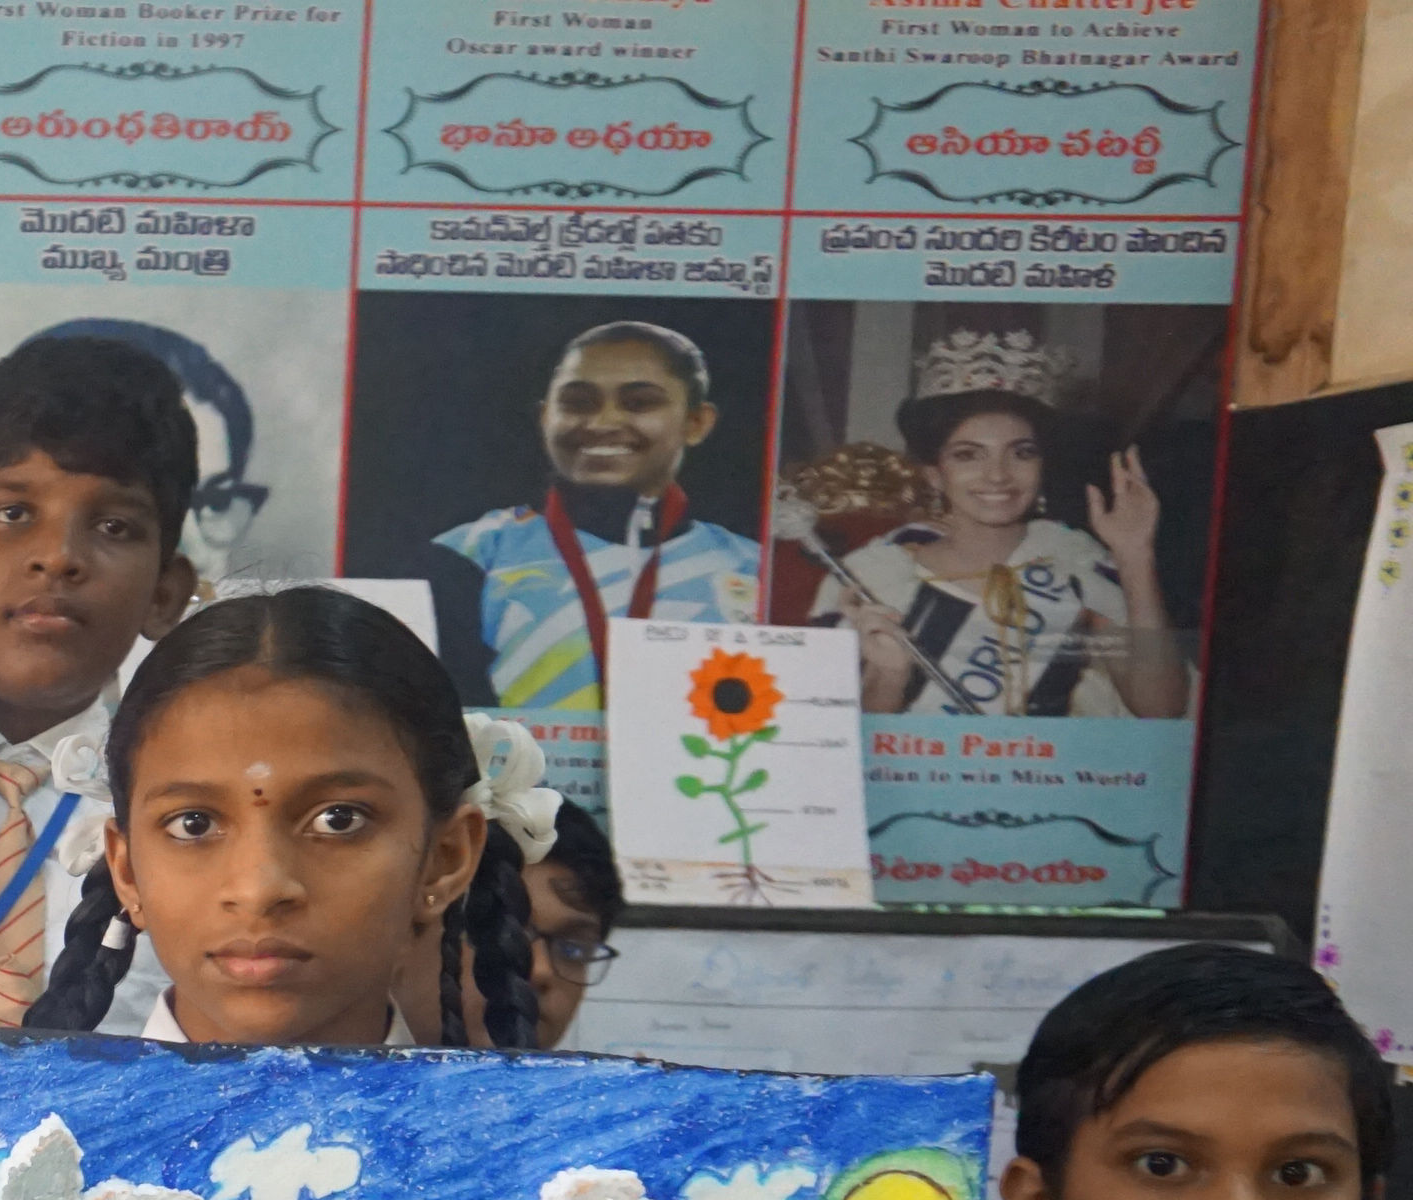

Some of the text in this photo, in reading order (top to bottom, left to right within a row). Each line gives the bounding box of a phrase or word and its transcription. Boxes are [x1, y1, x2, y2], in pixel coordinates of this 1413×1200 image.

[39, 3, 127, 19] Woman
[139, 4, 224, 20] Booker
[235, 6, 297, 22] Prize
[306, 6, 341, 23] for
[494, 11, 653, 30] First Woman
[881, 19, 1180, 38] First Woman to Achieve
[61, 31, 246, 49] Fiction in 1997
[446, 38, 698, 60] Oscar award winner
[817, 46, 1239, 70] Santhi Swaroop Bhatnagar Award
[20, 207, 255, 237] మొదటి మహిళా
[925, 259, 1116, 290] మొదటి మహిళ
[872, 733, 946, 757] Rita
[961, 734, 1055, 758] Paria
[930, 770, 949, 784] to
[962, 772, 1001, 785] win
[1012, 770, 1065, 786] Miss
[1076, 771, 1147, 787] World
